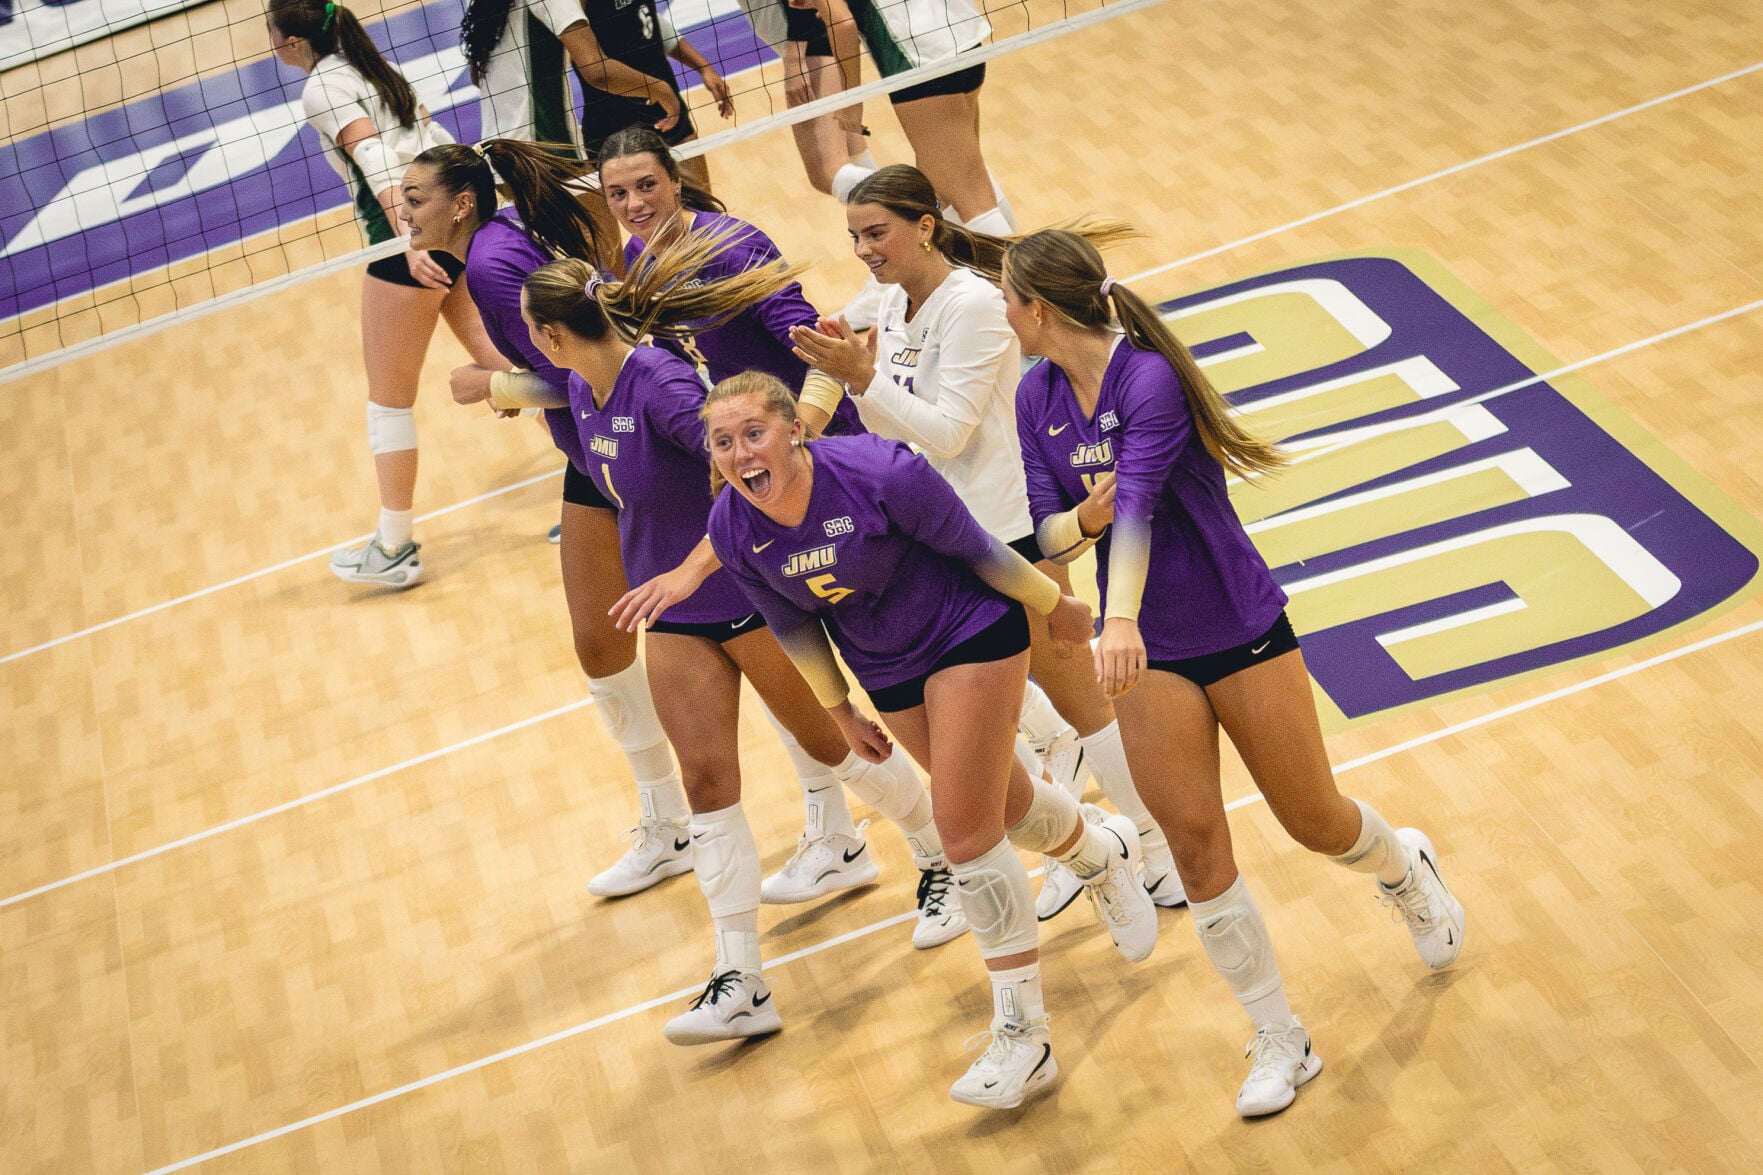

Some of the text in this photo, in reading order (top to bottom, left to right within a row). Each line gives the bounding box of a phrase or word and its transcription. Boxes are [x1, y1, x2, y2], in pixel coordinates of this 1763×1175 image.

[611, 416, 635, 432] SBC
[590, 434, 618, 459] JMU
[601, 463, 625, 509] 1
[823, 516, 854, 537] SBC
[781, 543, 837, 577] JMU
